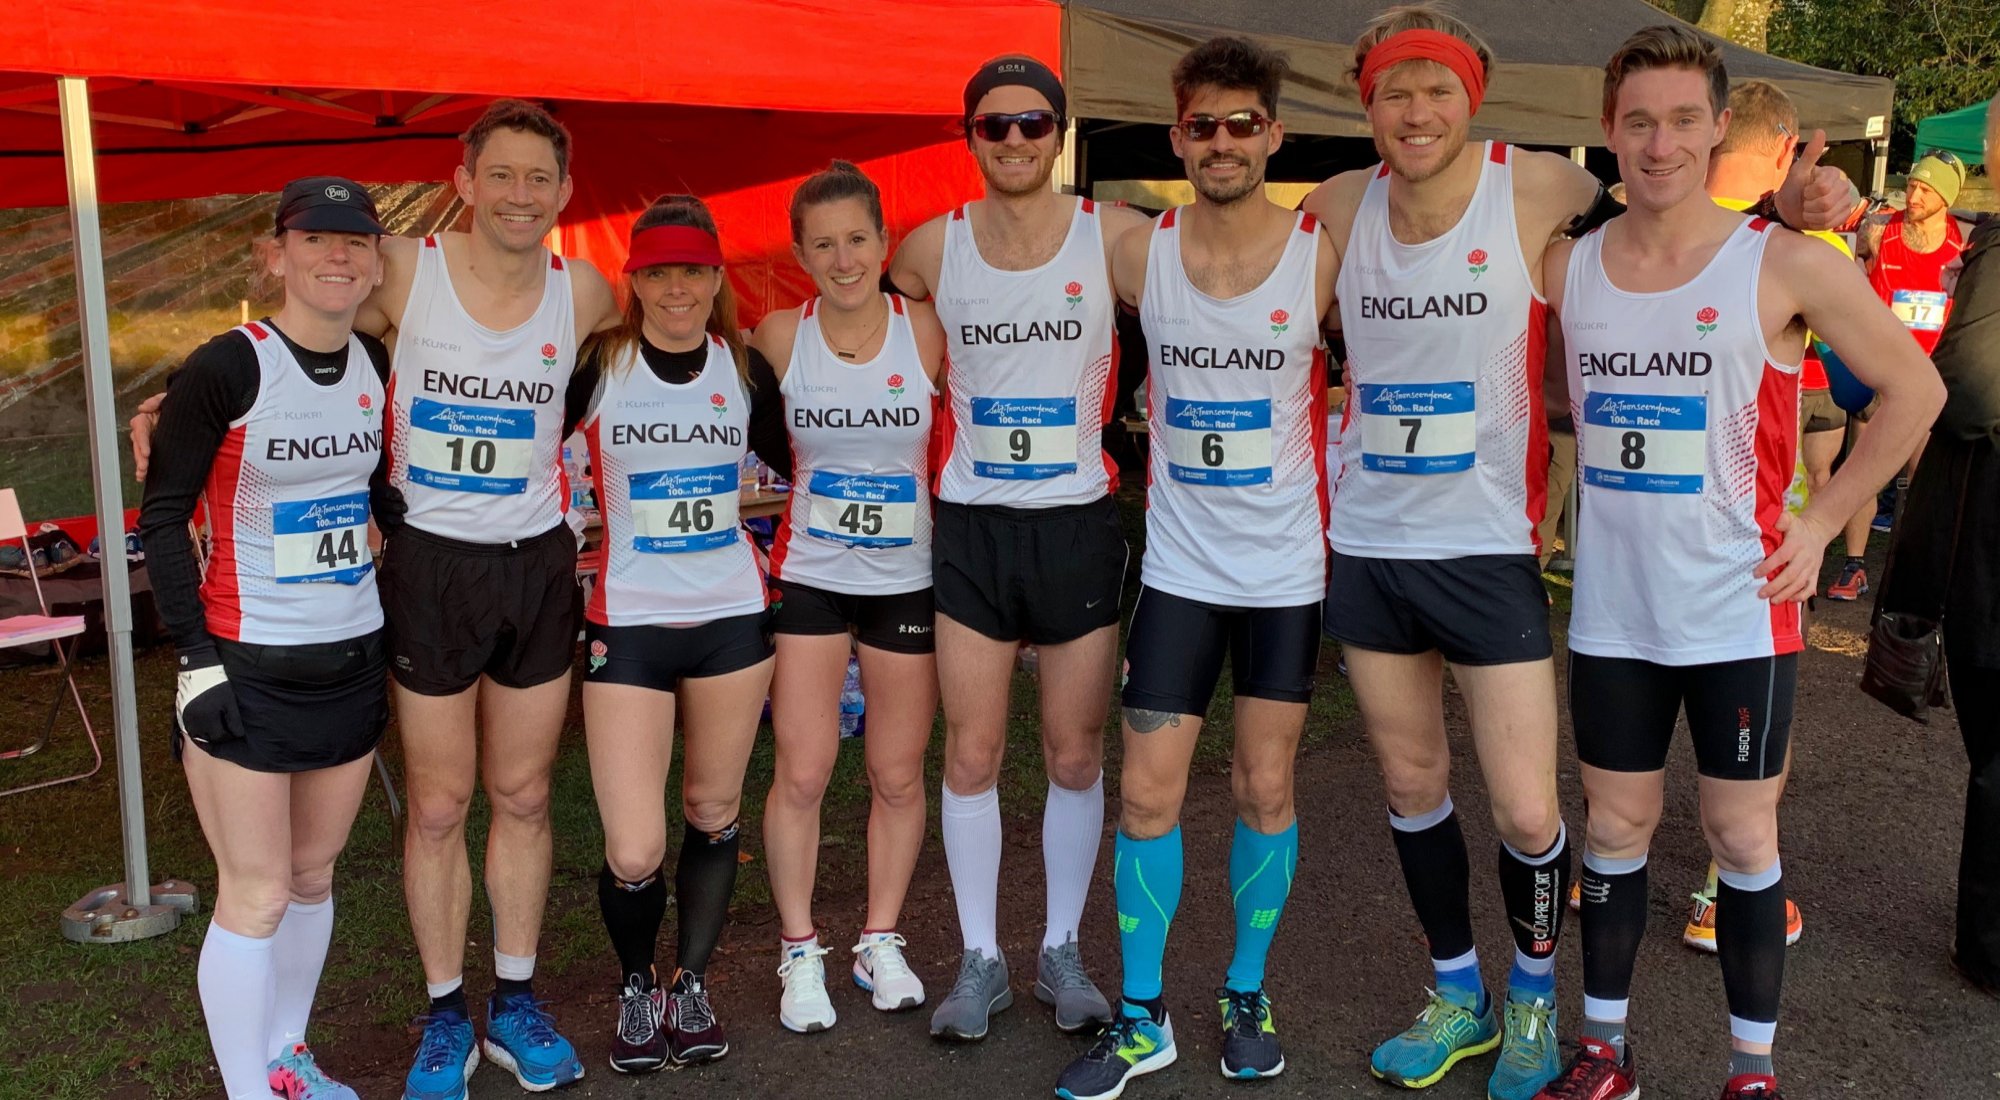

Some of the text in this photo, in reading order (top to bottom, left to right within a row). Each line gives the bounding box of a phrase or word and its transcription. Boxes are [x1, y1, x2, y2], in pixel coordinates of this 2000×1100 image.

[329, 187, 347, 199] Buff
[1361, 292, 1488, 320] ENGLAND
[1909, 305, 1931, 321] 17
[961, 319, 1082, 345] ENGLAND
[421, 337, 462, 353] KUKRI
[1160, 344, 1285, 371] ENGLAND
[1579, 351, 1713, 377] ENGLAND
[424, 369, 555, 405] ENGLAND
[284, 411, 322, 421] KUKRI
[794, 407, 920, 428] ENGLAND
[1412, 404, 1435, 412] Race
[475, 426, 498, 436] Race
[1022, 416, 1042, 424] Race
[1215, 420, 1236, 429] Race
[1636, 416, 1661, 426] Race
[612, 423, 742, 447] ENGLAND
[1009, 429, 1031, 462] 9
[1399, 418, 1422, 454] 7
[446, 437, 497, 475] 10
[1201, 433, 1225, 467] 6
[1620, 431, 1646, 470] 8
[692, 486, 712, 495] Race
[866, 491, 886, 500] Race
[336, 516, 355, 525] Race
[668, 498, 714, 534] 46
[838, 503, 883, 536] 45
[316, 529, 359, 569] 44
[908, 625, 933, 634] KUK
